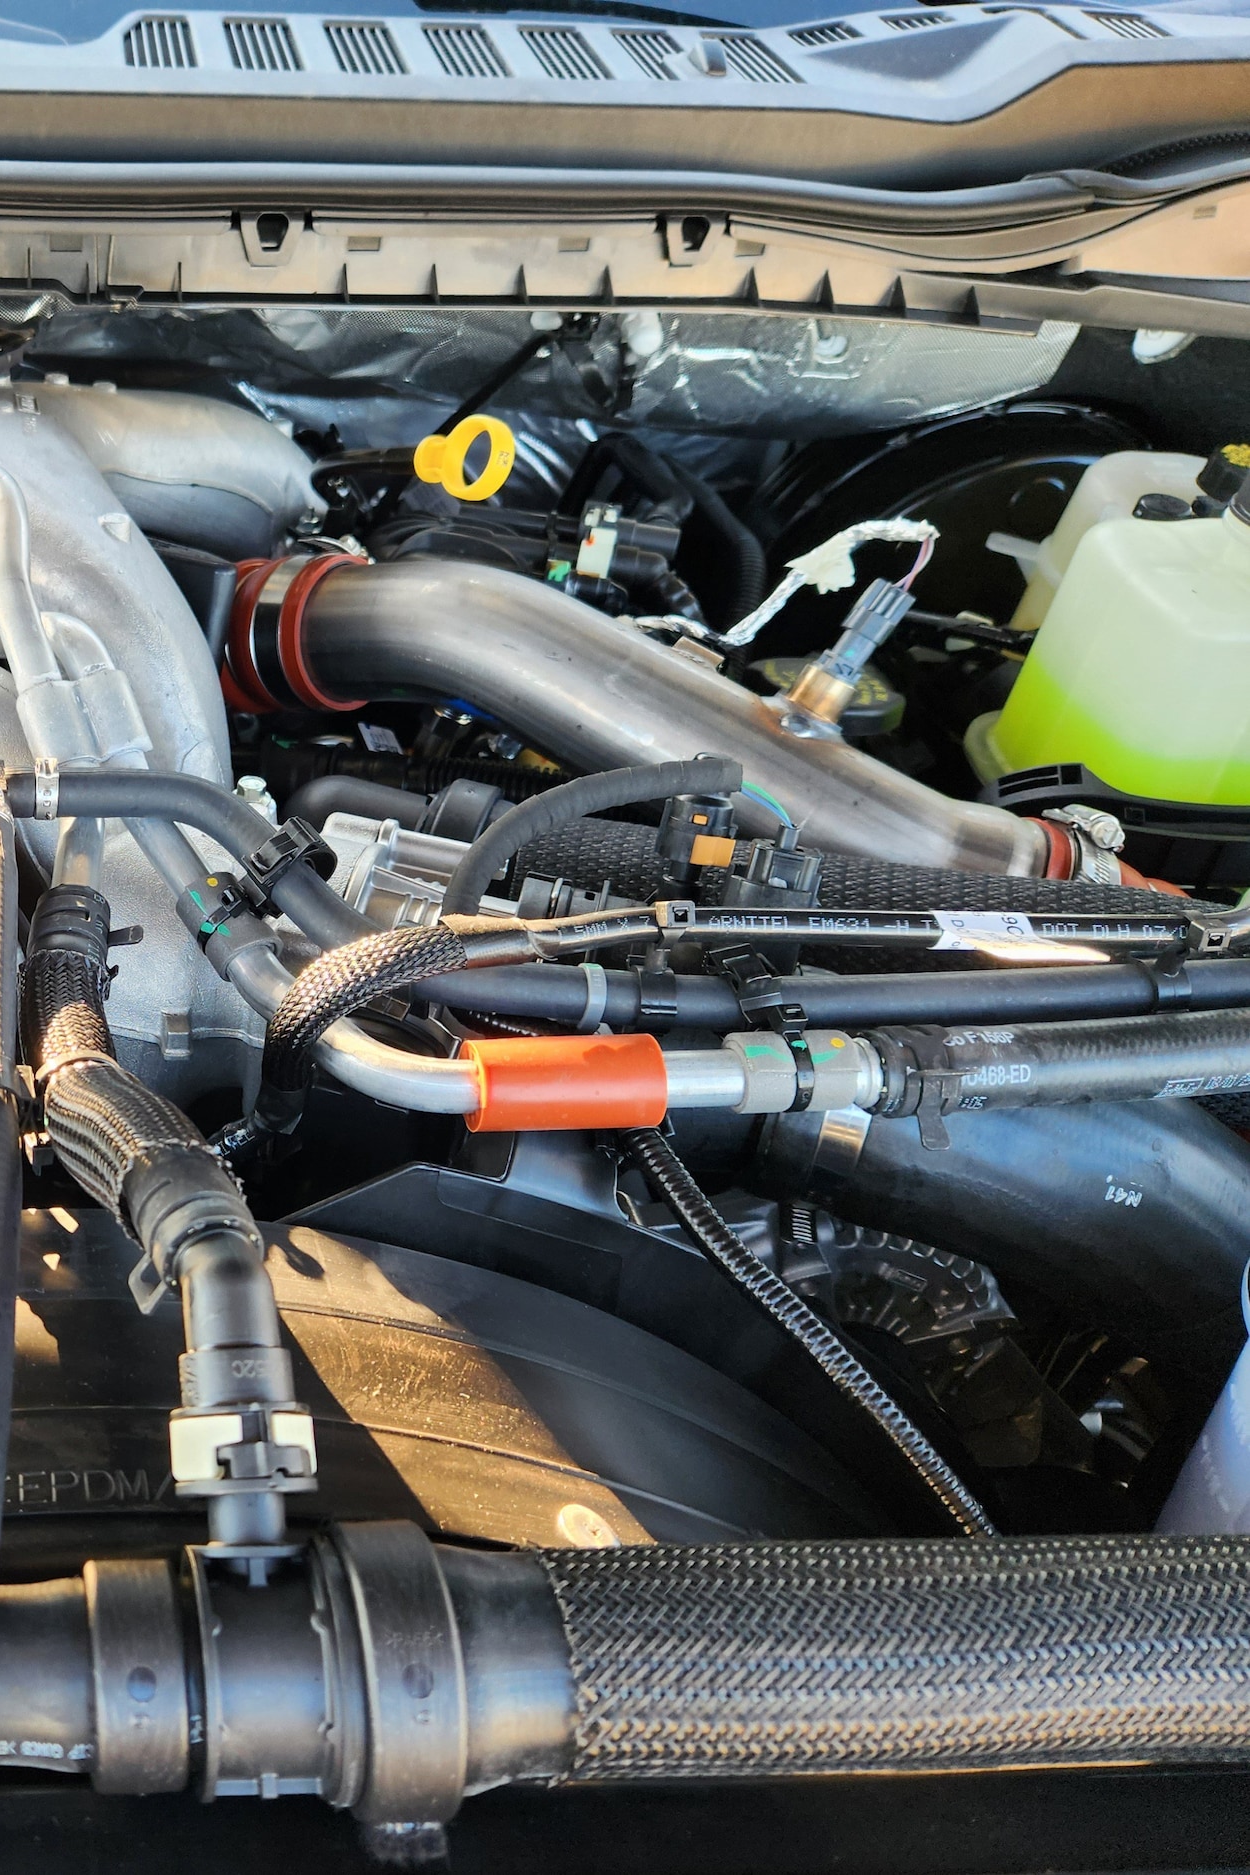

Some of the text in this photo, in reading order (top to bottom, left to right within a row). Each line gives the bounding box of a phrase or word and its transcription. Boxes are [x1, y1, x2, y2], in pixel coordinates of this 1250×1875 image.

[708, 915, 795, 932] ARNITEL
[808, 916, 871, 933] EM631
[1142, 924, 1188, 940] 07/0
